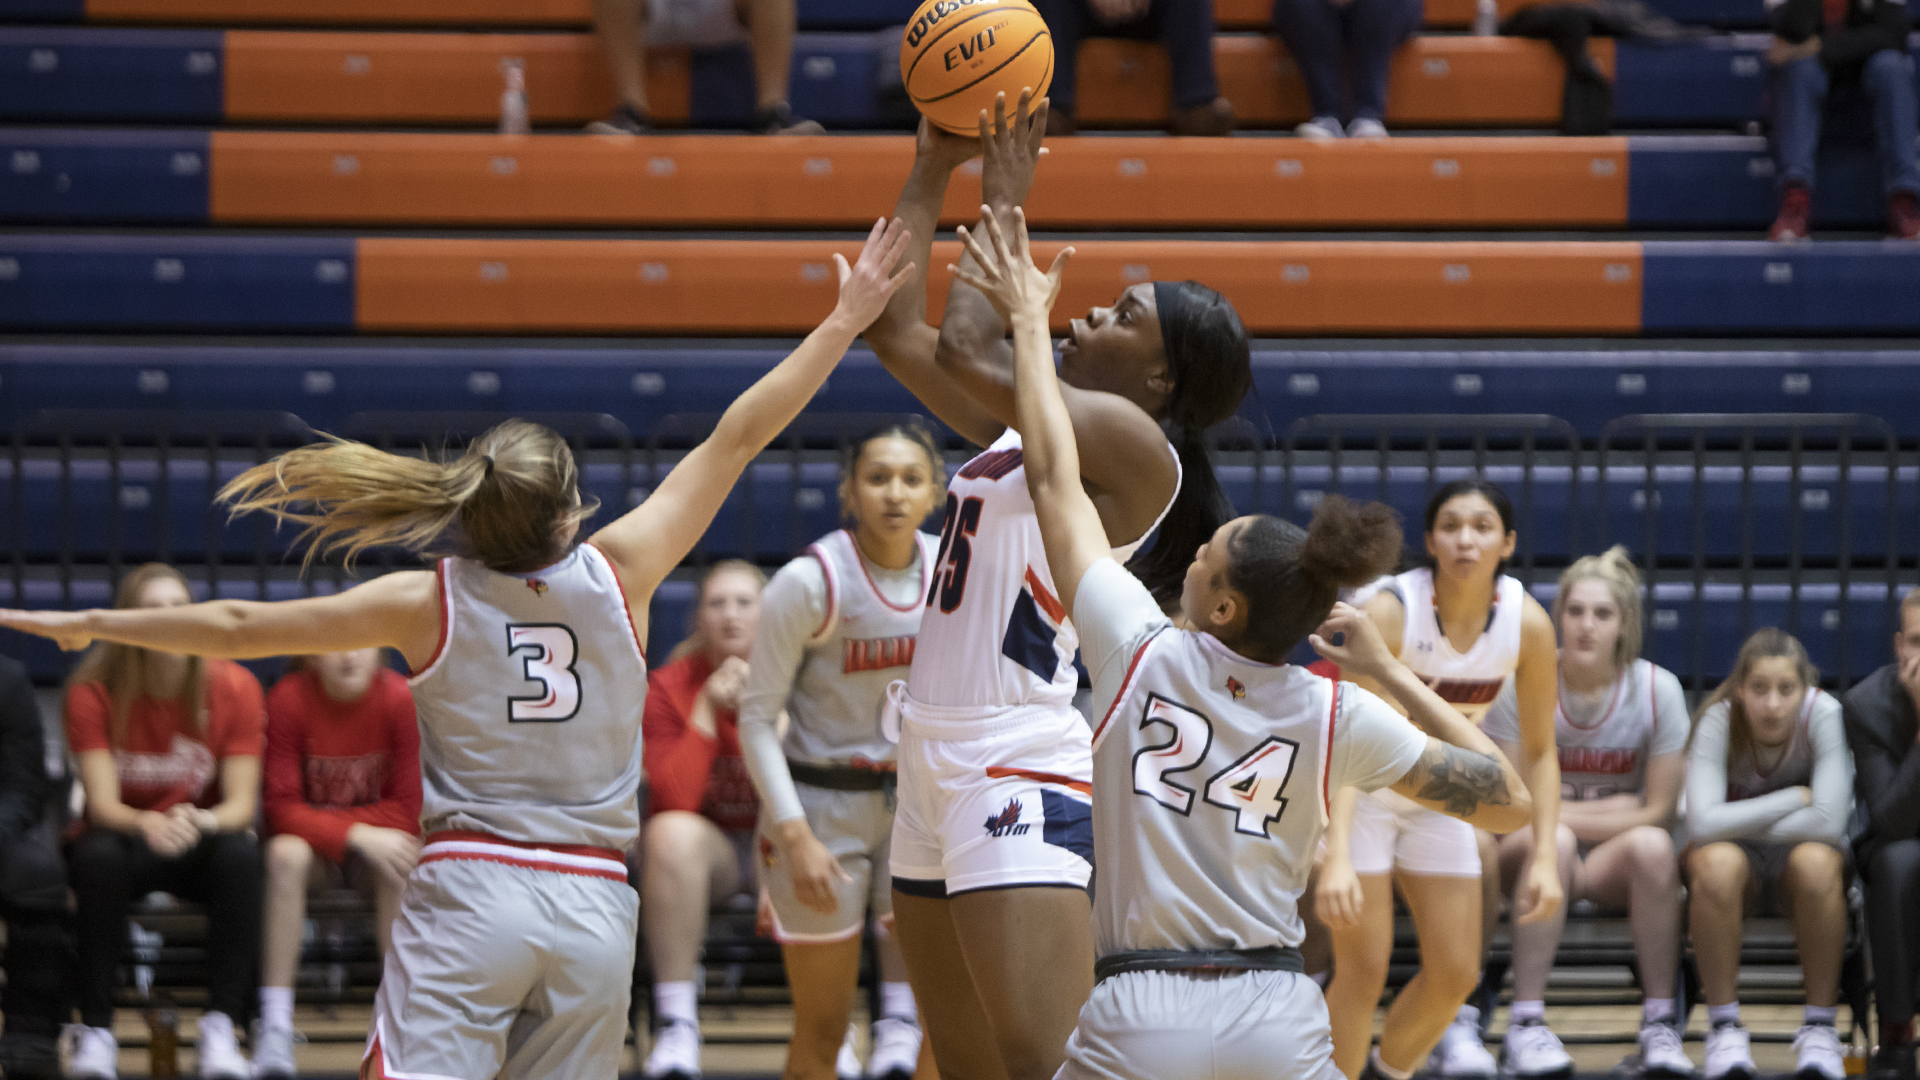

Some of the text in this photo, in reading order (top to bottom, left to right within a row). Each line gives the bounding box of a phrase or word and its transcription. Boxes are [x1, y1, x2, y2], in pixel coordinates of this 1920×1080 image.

[907, 0, 998, 47] Wilso
[944, 26, 995, 72] EVO
[926, 490, 985, 615] 25
[505, 622, 583, 723] 3
[1131, 690, 1300, 840] 24
